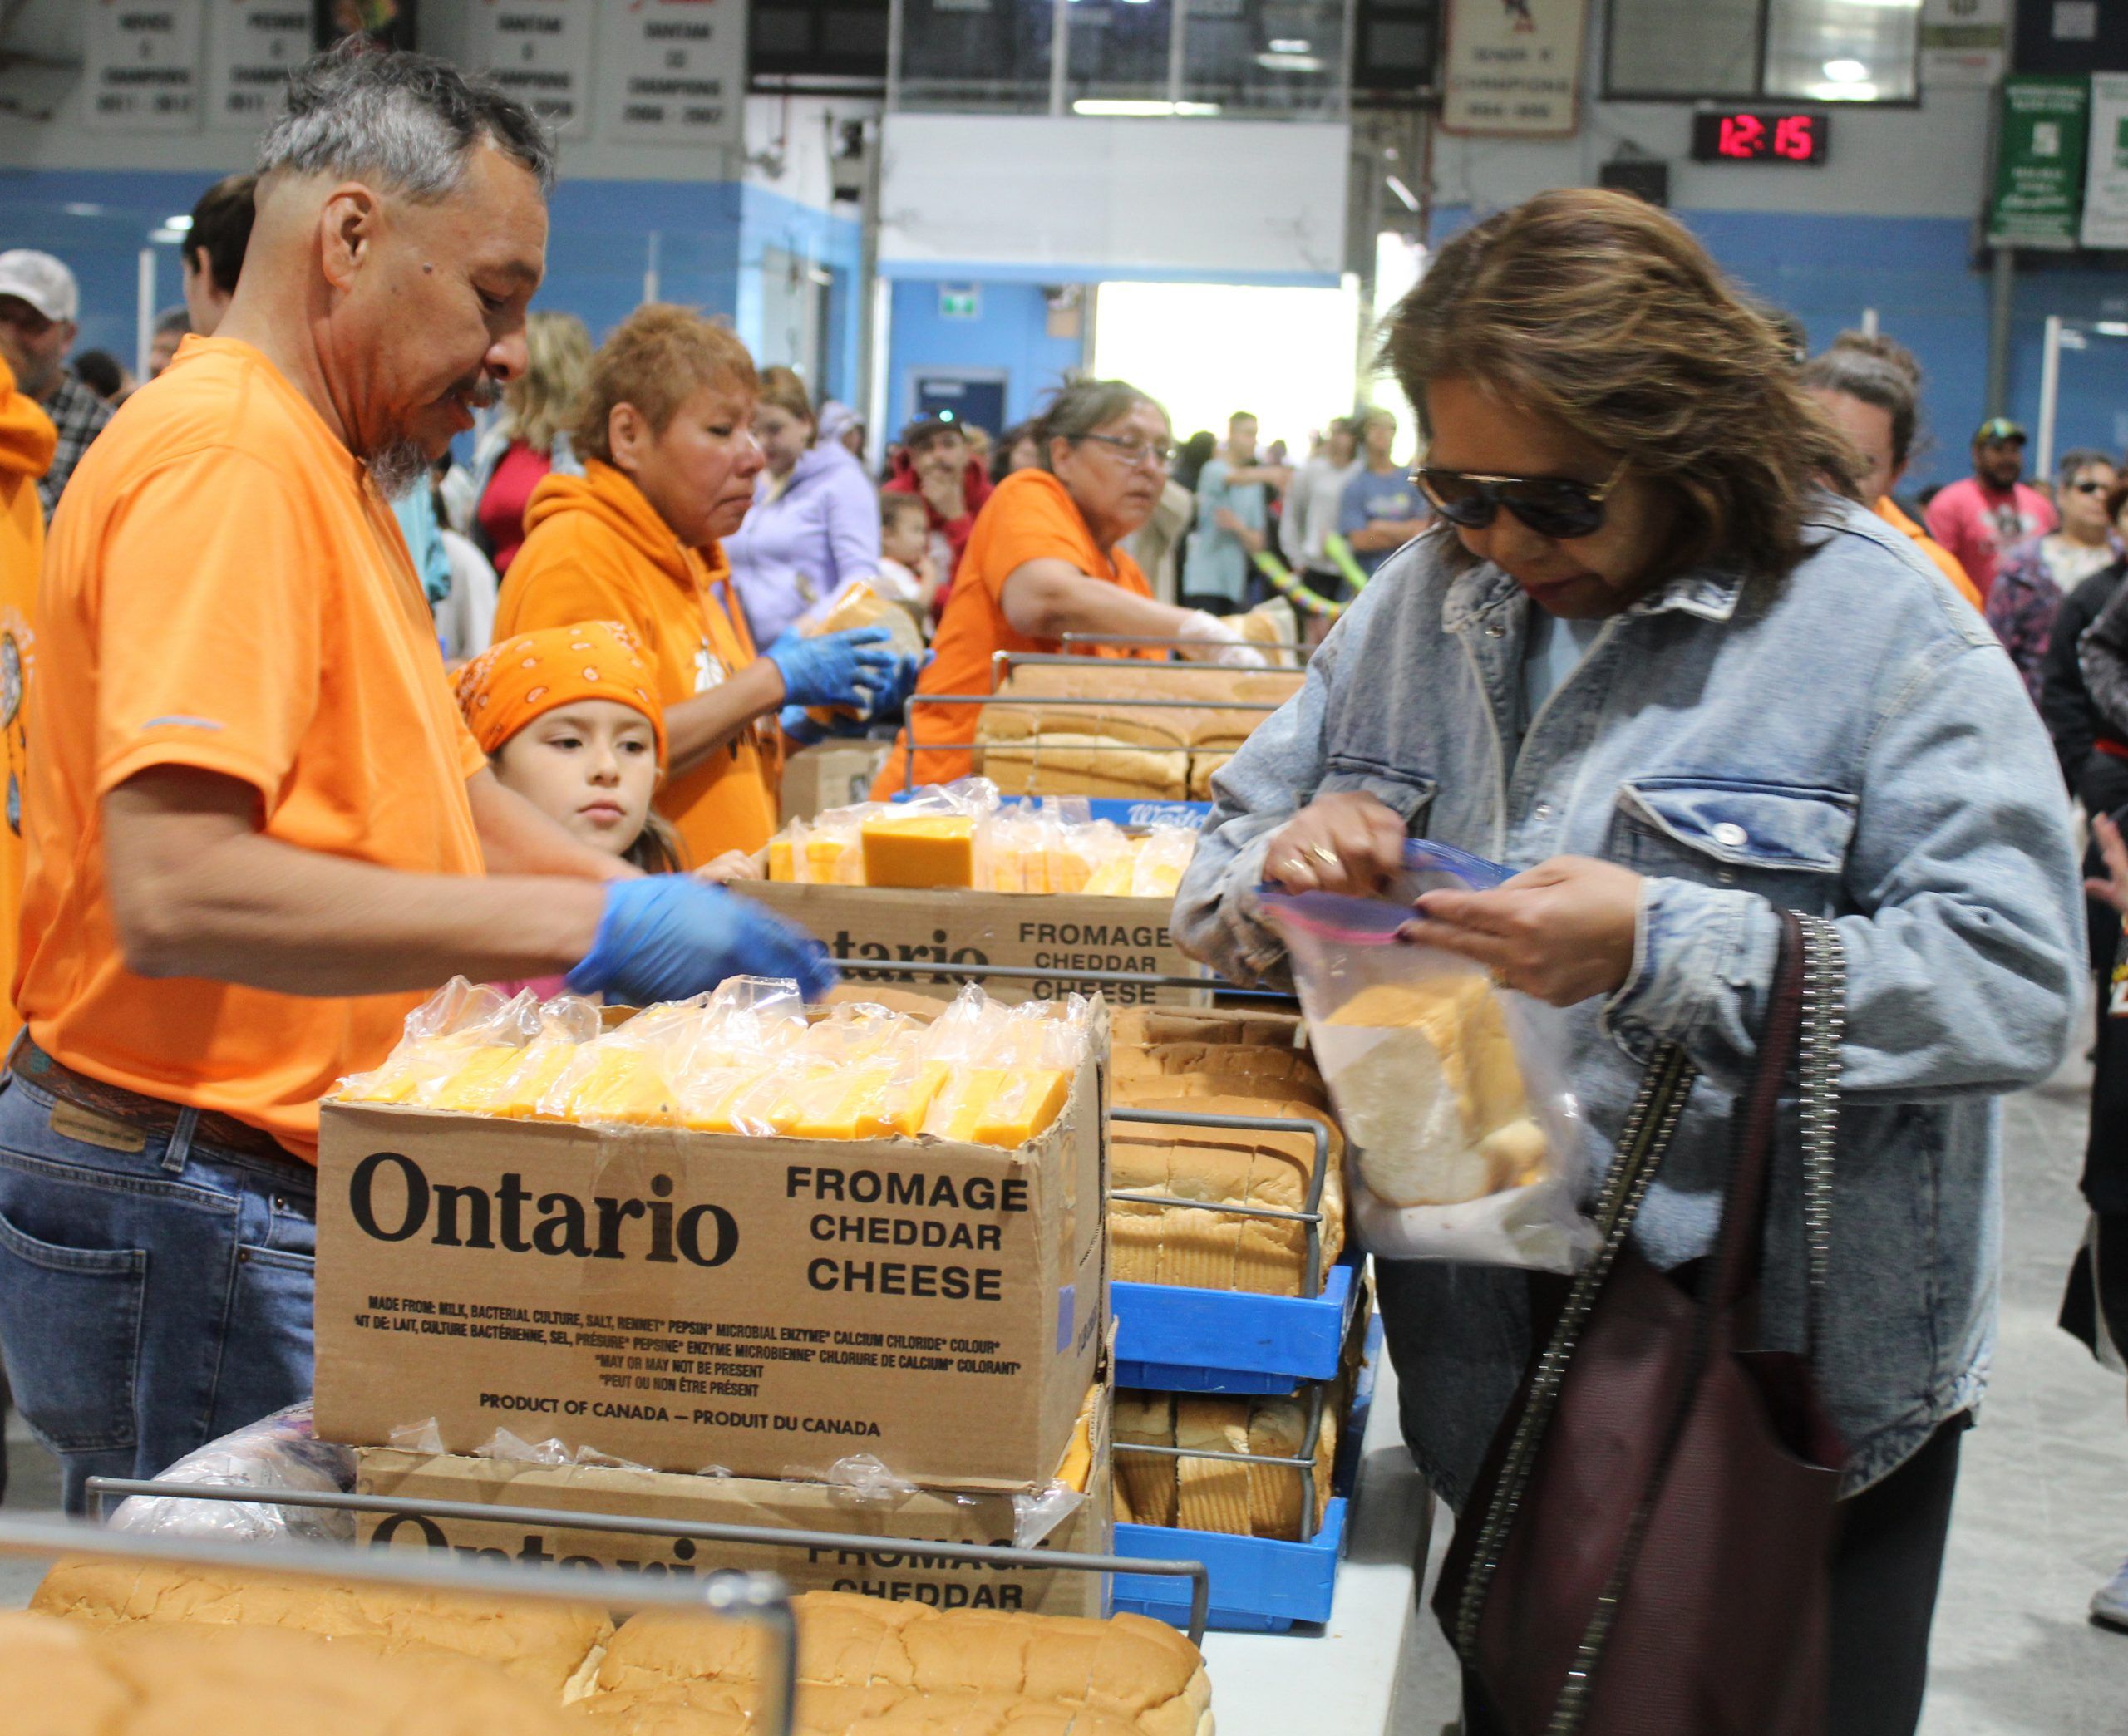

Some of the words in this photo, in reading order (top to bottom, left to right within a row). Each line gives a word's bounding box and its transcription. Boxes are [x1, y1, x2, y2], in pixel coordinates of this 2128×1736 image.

[1718, 114, 1813, 160] 12:15
[1019, 922, 1172, 947] FROMAGE
[1034, 952, 1156, 972] CHEDDAR
[1032, 980, 1156, 1004] CHEESE
[350, 1152, 739, 1266] Ontario
[786, 1166, 1028, 1212] FROMAGE
[810, 1214, 1002, 1251] CHEDDAR
[807, 1257, 1002, 1301] CHEESE
[368, 1295, 399, 1311] MADE
[402, 1298, 436, 1315] FROM:
[439, 1301, 468, 1320] MILK,
[470, 1304, 530, 1323] BACTERIAL
[533, 1310, 583, 1329] CULTURE,
[586, 1314, 615, 1330] SALT,
[716, 1323, 777, 1340] MICROBIAL
[834, 1330, 884, 1347] CALCIUM
[373, 1316, 390, 1330] DE:
[393, 1317, 419, 1335] LAIT,
[421, 1320, 468, 1337] CULTURE
[470, 1324, 548, 1345] BACTÉRIENNE,
[549, 1330, 573, 1347] SEL,
[687, 1340, 732, 1357] ENZYME
[819, 1350, 879, 1367] CHLORURE
[880, 1354, 896, 1368] DE
[627, 1356, 642, 1370] OR
[645, 1358, 669, 1372] MAY
[672, 1360, 695, 1374] NOT
[697, 1361, 712, 1375] BE
[714, 1362, 764, 1378] PRESENT
[635, 1375, 651, 1389] OU
[653, 1377, 676, 1392] NON
[679, 1376, 707, 1394] ÊTRE
[709, 1380, 760, 1397] PRÉSENT
[480, 1393, 559, 1413] PRODUCT
[564, 1400, 588, 1415] OF
[592, 1402, 669, 1422] CANADA
[693, 1409, 769, 1429] PRODUIT
[773, 1415, 798, 1431] DU
[801, 1418, 881, 1437] CANADA
